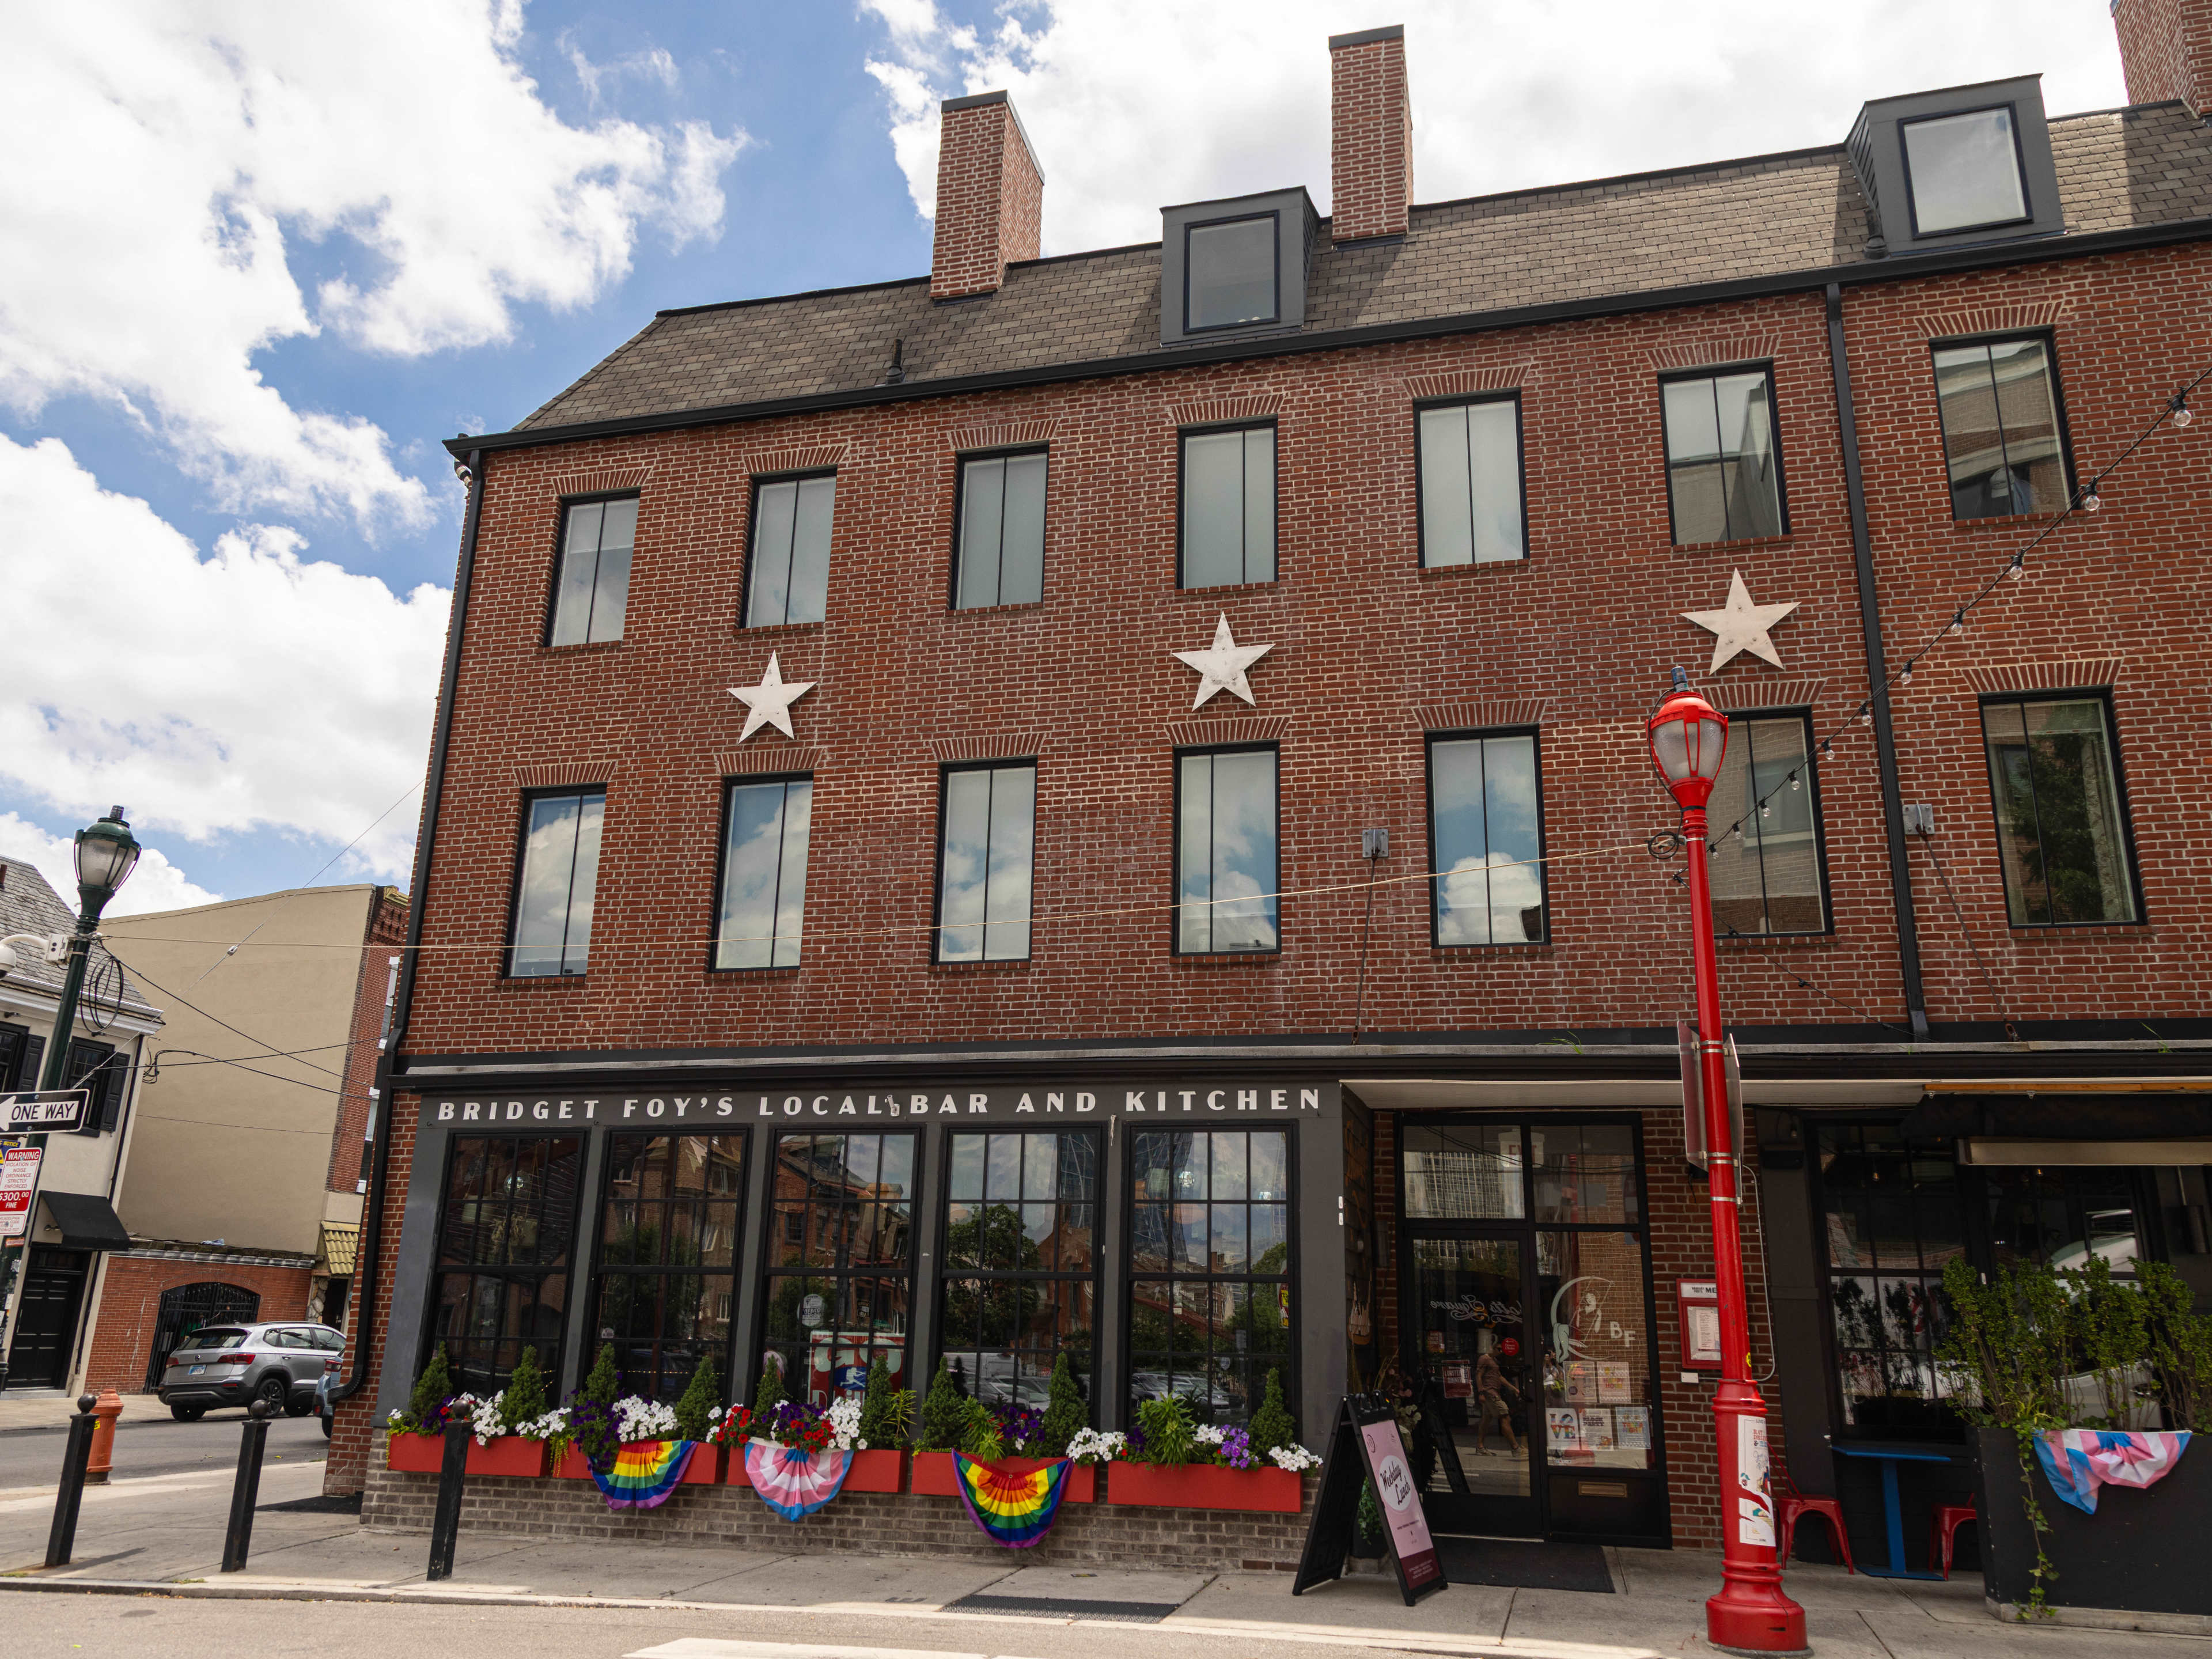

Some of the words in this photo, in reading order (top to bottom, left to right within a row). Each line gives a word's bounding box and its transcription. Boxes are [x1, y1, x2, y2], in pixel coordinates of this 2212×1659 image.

[12, 1105, 41, 1120] ONE
[45, 1103, 75, 1119] WAY
[438, 1100, 599, 1120] BRIDGET
[623, 1097, 733, 1117] FOY'S
[760, 1096, 882, 1116] LOCAL
[910, 1094, 988, 1114] BAR
[1016, 1093, 1096, 1112] AND
[1126, 1089, 1319, 1112] KITCHEN
[8, 1151, 40, 1161] WARNING
[1509, 1145, 1537, 1165] EXT
[815, 1337, 902, 1374] GO
[1380, 1461, 1402, 1494] Weekday
[1395, 1475, 1411, 1505] Lunch
